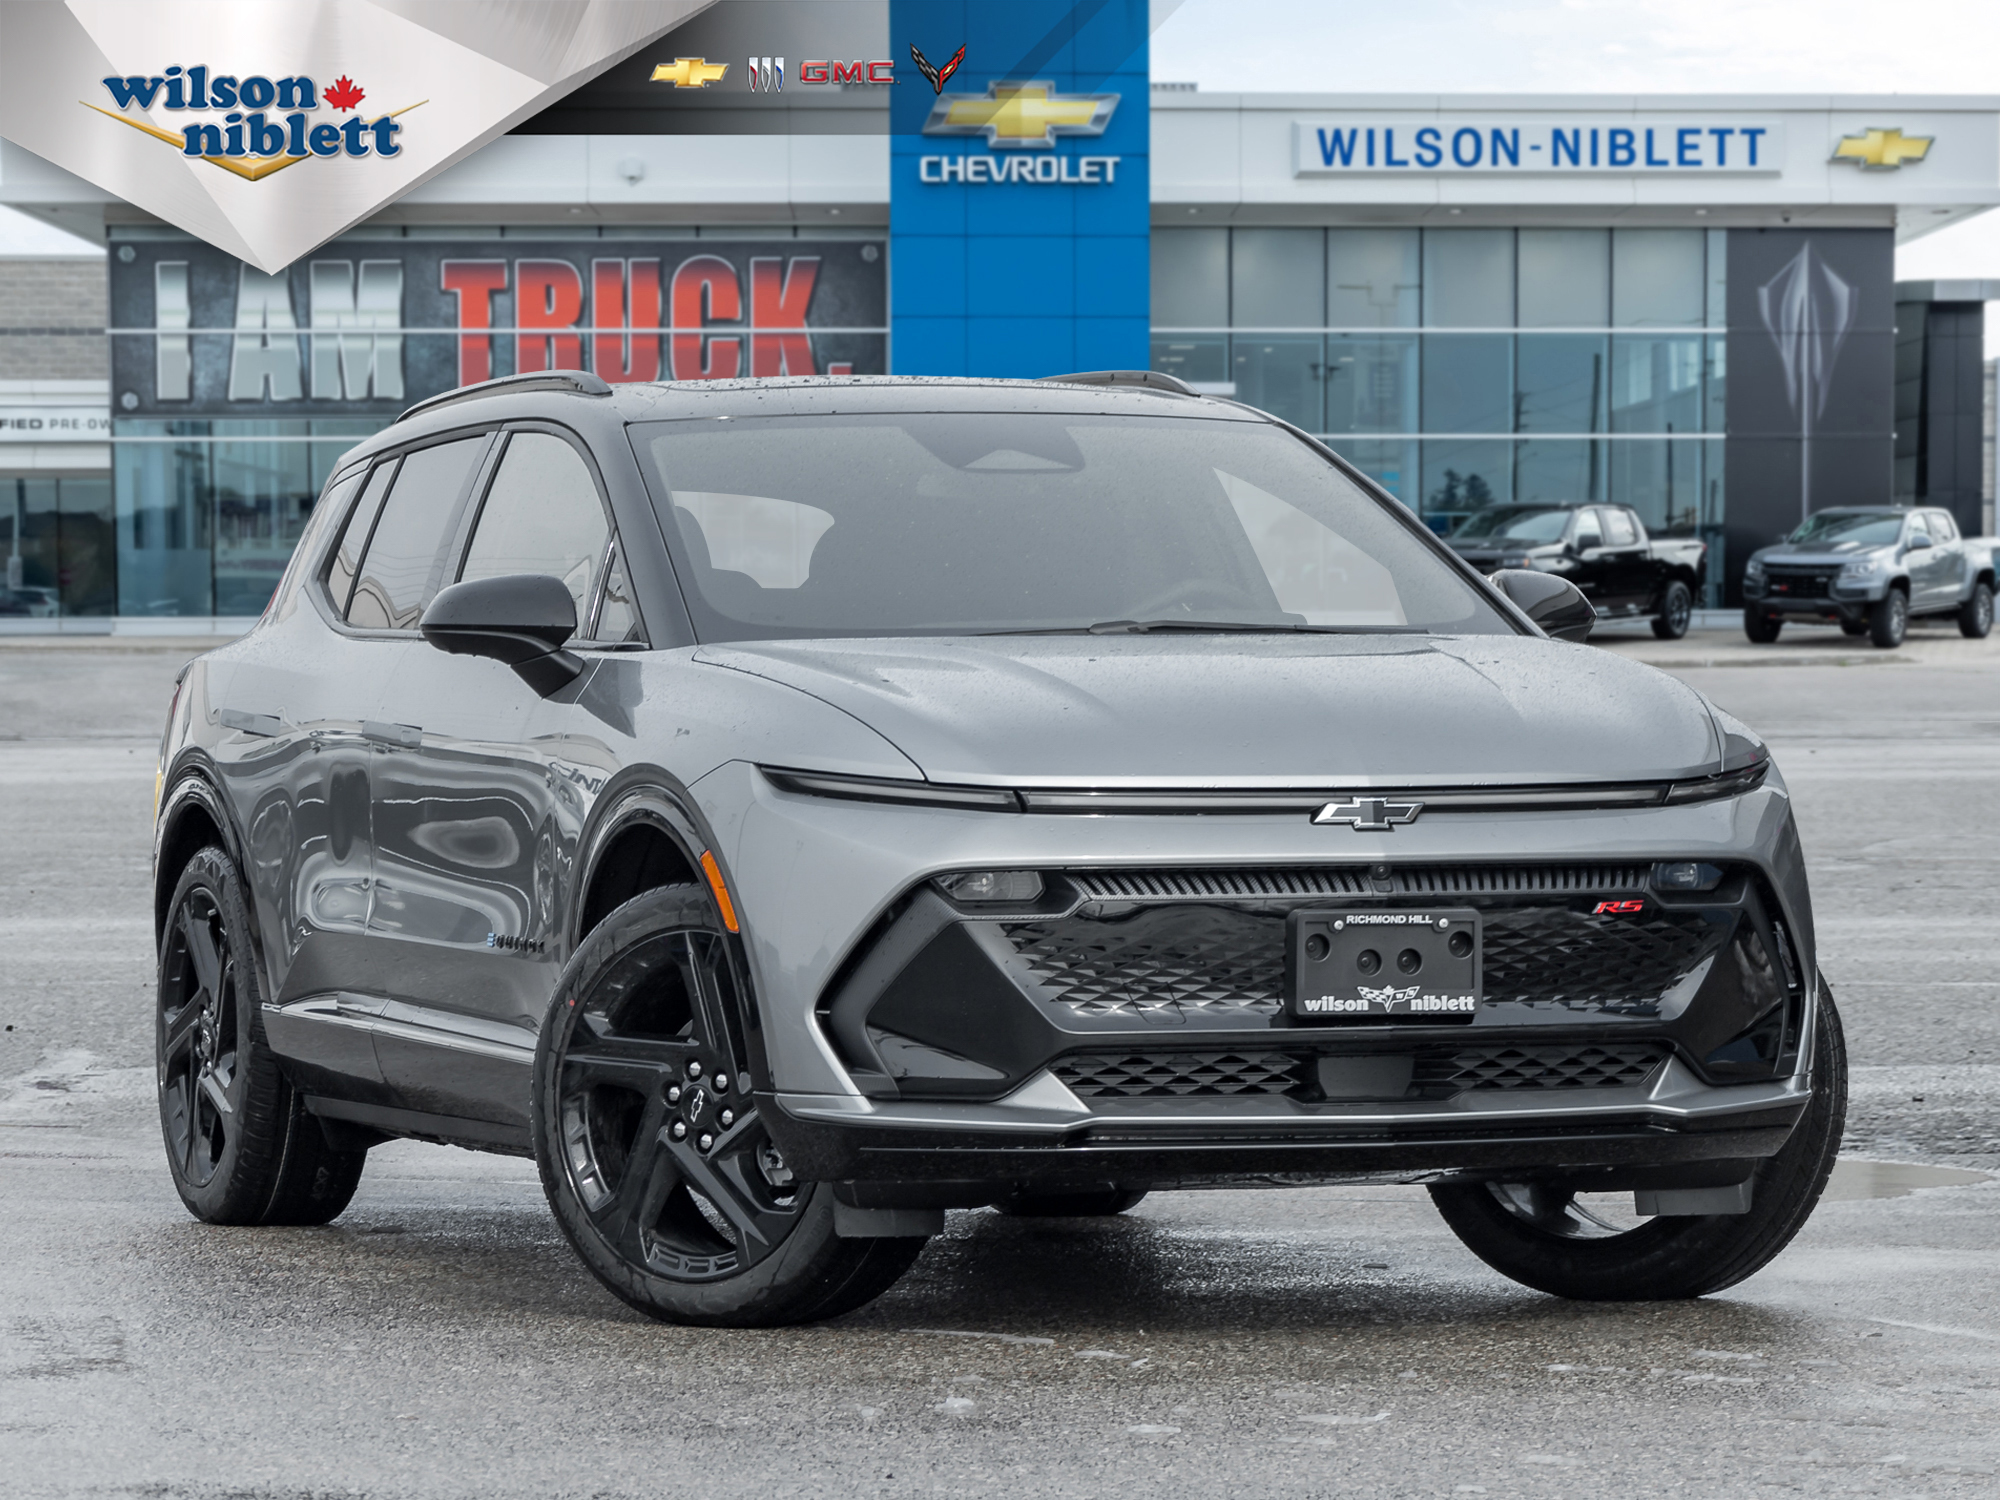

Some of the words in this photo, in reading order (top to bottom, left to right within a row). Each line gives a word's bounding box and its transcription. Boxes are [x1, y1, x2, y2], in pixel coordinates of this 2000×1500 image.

[1317, 126, 1767, 168] WILSON-NIBLETT
[920, 156, 1121, 184] CHEVROLET
[155, 260, 190, 400] I
[228, 259, 404, 400] AM
[1591, 900, 1644, 915] RS
[1346, 915, 1407, 925] RICHMOND
[1408, 915, 1433, 924] HILL
[1304, 996, 1369, 1012] wilson
[1410, 995, 1475, 1011] niblett
